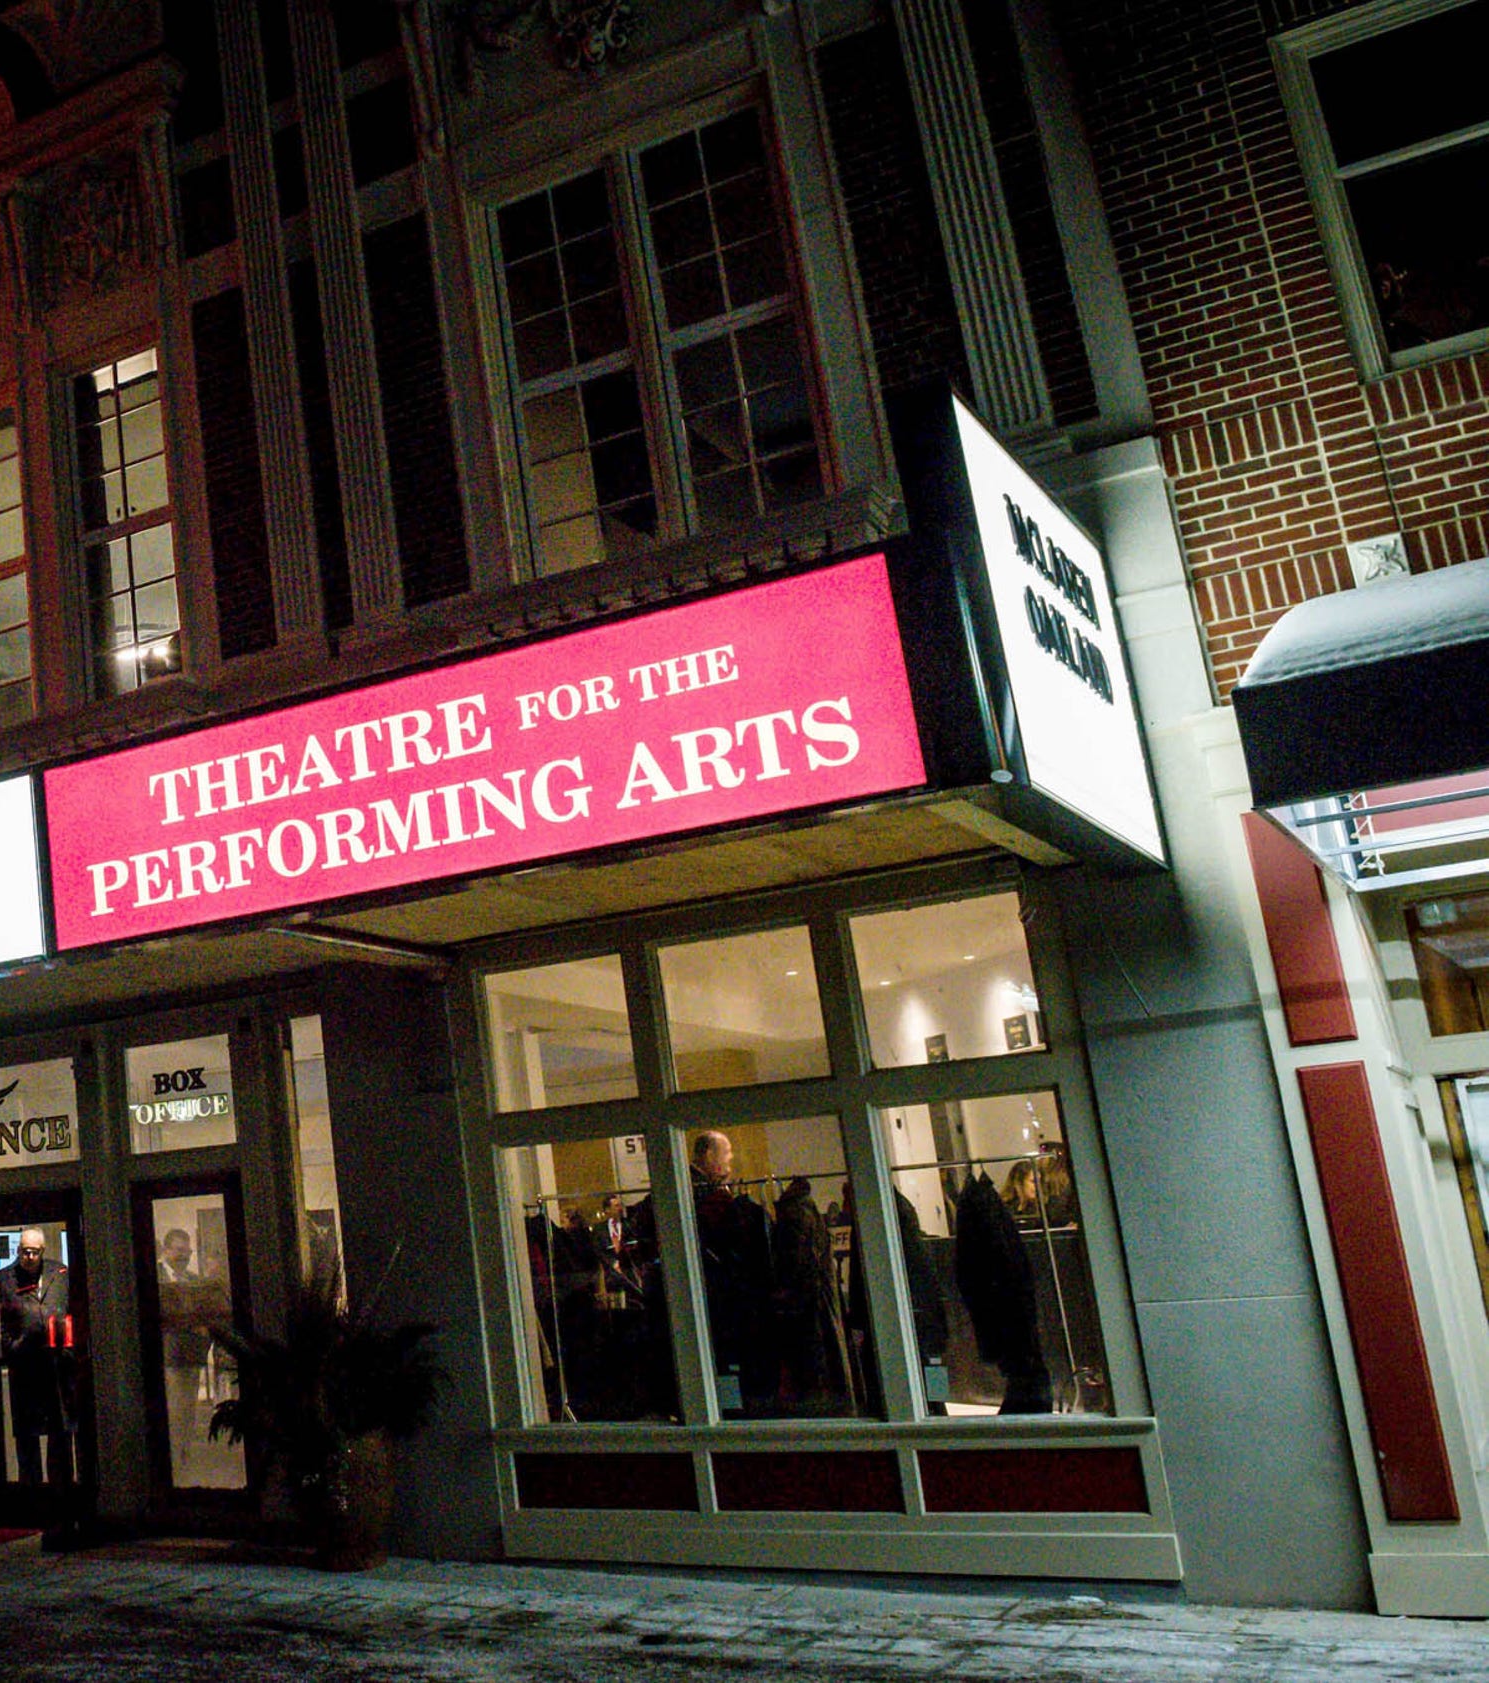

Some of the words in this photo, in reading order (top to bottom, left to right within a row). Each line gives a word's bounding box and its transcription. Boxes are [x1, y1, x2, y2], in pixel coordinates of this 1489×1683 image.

[1002, 493, 1101, 631] MCLAREN
[1024, 585, 1114, 705] OAKLAND
[149, 693, 493, 826] THEATRE
[515, 675, 621, 731] FOR
[628, 644, 739, 702] THE
[86, 755, 593, 917] PERFORMING
[616, 696, 860, 810] ARTS
[135, 1093, 228, 1124] OFFICE
[153, 1067, 207, 1095] BOX
